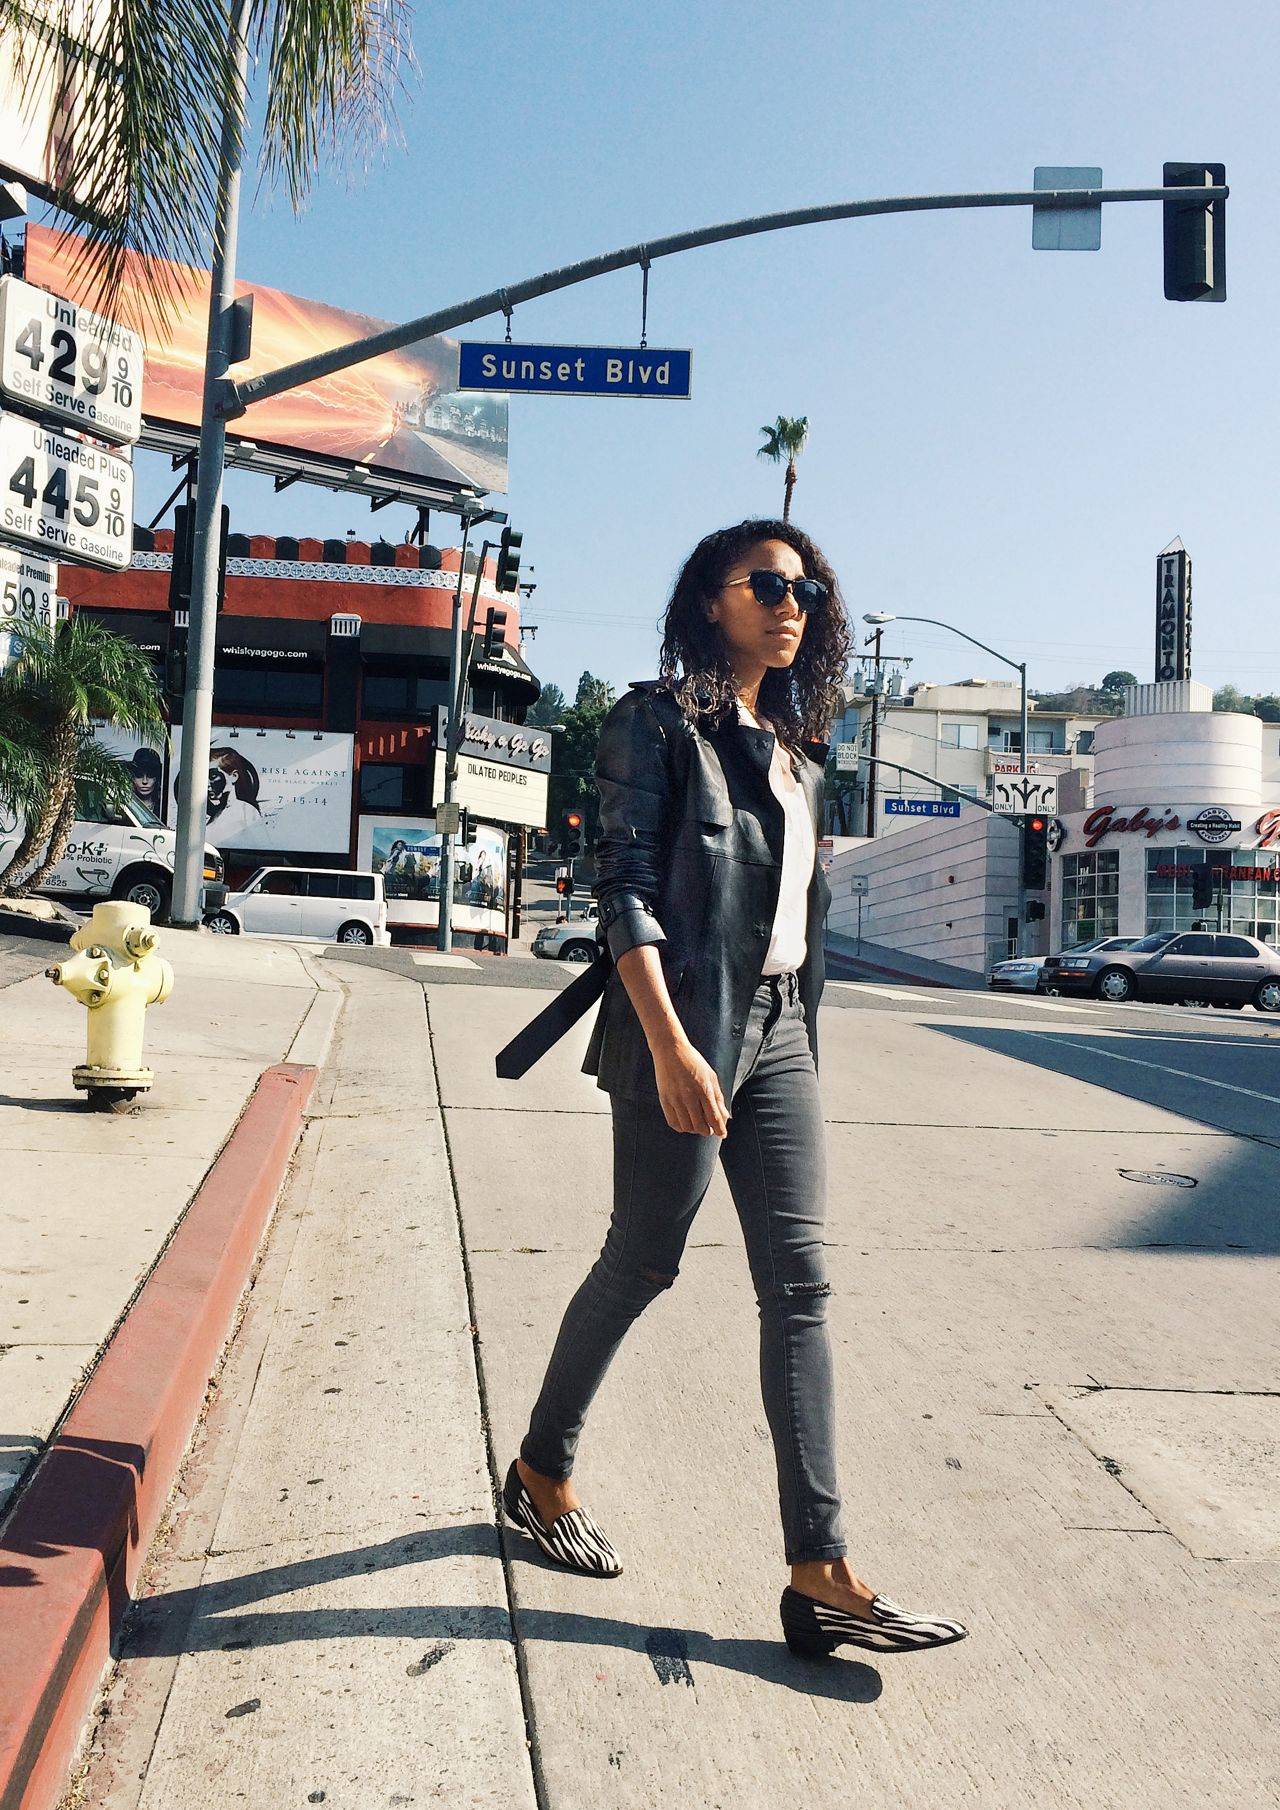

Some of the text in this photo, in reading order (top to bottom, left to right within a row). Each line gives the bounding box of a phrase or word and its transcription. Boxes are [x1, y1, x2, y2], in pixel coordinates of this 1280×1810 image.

[46, 298, 132, 352] Unleaded
[15, 318, 108, 396] 429
[481, 353, 670, 385] Sunset Blvd
[12, 370, 132, 433] Self Serve Gasoline
[33, 429, 127, 483] Unleaded Plus
[9, 455, 100, 527] 445
[4, 507, 124, 562] Self Serve Gasoline
[26, 565, 55, 585] Premium
[1160, 558, 1175, 680] TRAMONTO
[222, 646, 308, 659] whiskyagogo.com
[476, 662, 532, 682] whiskyagogo.com
[837, 752, 858, 760] BLOCK
[261, 767, 347, 778] RISE AGAINST
[467, 763, 527, 786] DILATED PEOPLES
[891, 802, 954, 814] Sunset Blvd
[994, 803, 1013, 811] ONLY
[1037, 805, 1055, 813] ONLY
[1083, 805, 1181, 848] Gaby's
[77, 854, 113, 864] Probiotic
